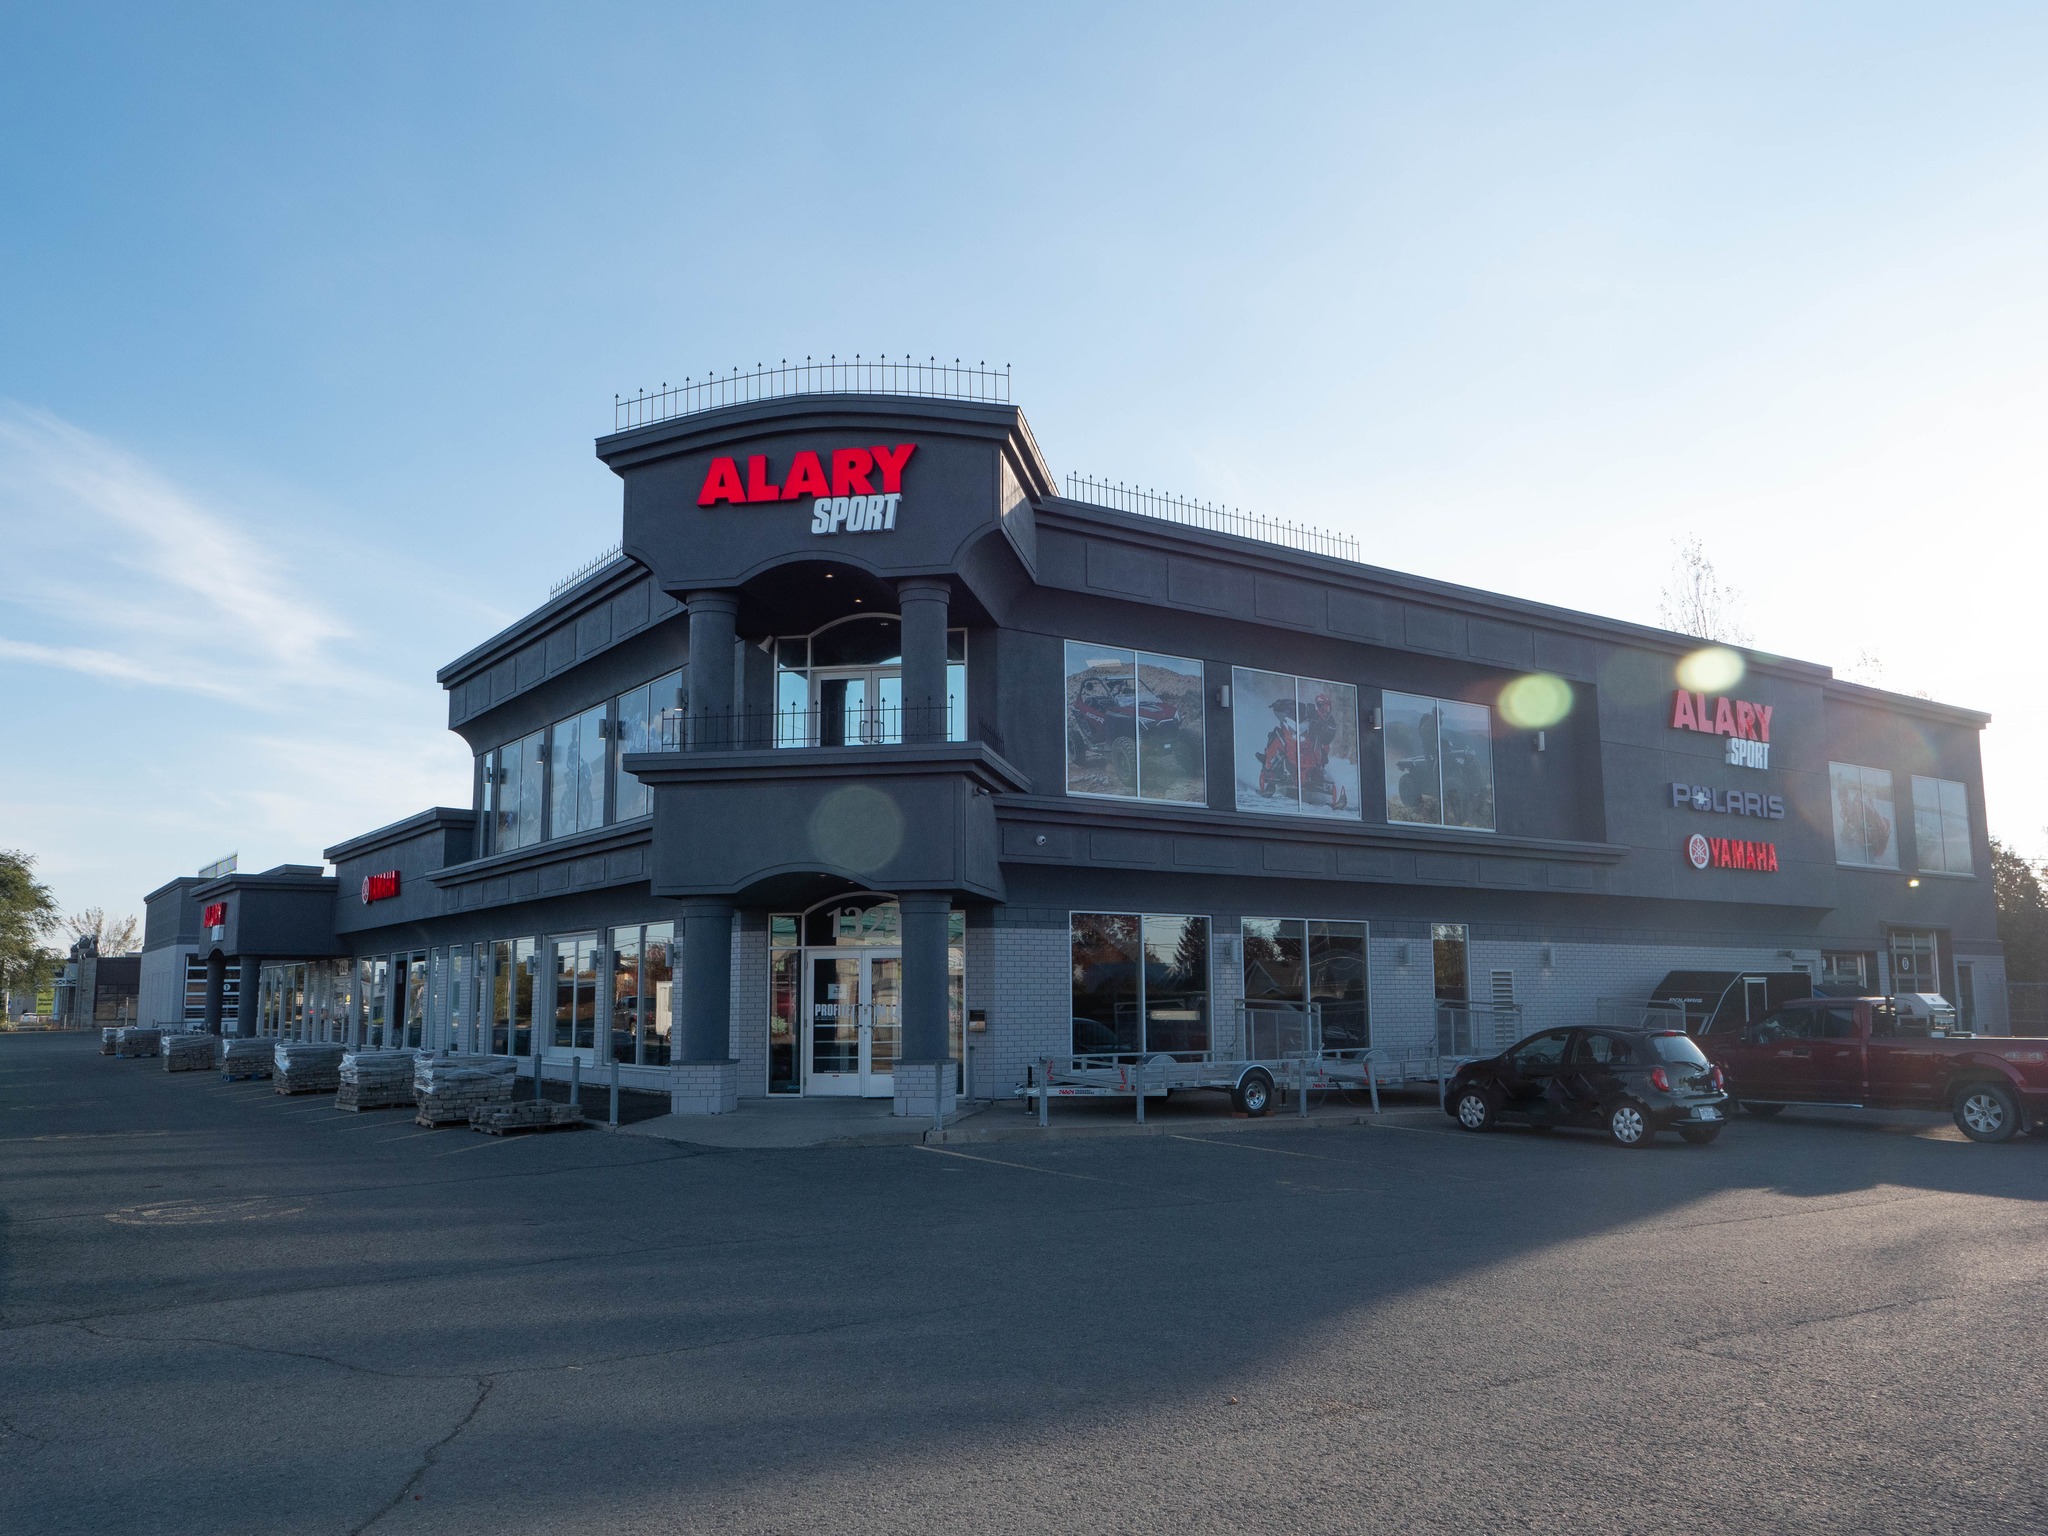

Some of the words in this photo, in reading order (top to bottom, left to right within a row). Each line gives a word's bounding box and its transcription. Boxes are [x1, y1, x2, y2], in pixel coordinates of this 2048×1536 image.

[697, 443, 918, 507] ALARY
[811, 493, 903, 535] SPORT
[1673, 689, 1773, 743] ALARY
[1727, 737, 1770, 770] SPORT
[1672, 782, 1785, 819] POLARIS
[1709, 837, 1779, 872] YAMAHA
[826, 906, 902, 938] 1324
